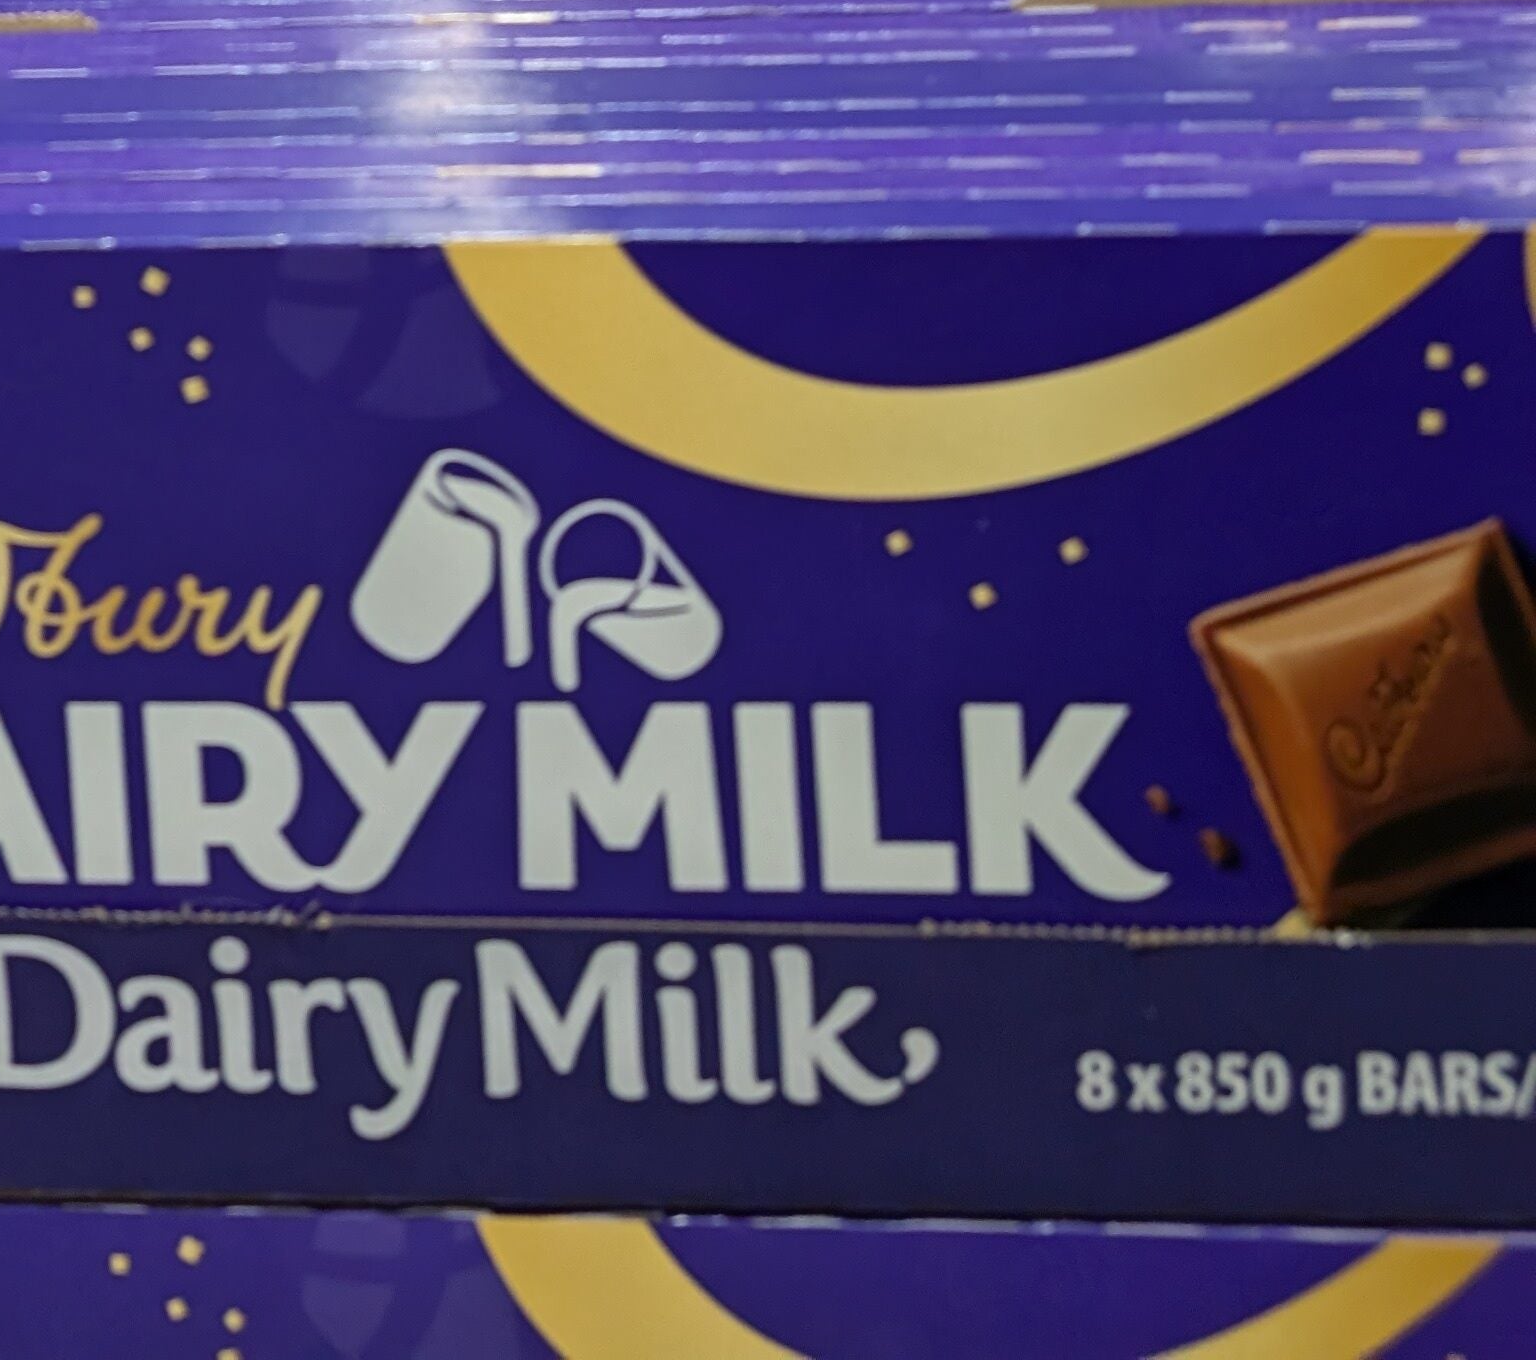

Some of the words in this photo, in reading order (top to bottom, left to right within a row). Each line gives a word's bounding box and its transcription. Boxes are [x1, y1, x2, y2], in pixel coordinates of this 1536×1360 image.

[515, 700, 1173, 902] MILK
[476, 939, 941, 1107] Milk
[1076, 1049, 1118, 1112] 8
[1126, 1063, 1164, 1112] x
[1174, 1050, 1291, 1114] 850
[1302, 1064, 1344, 1131] g
